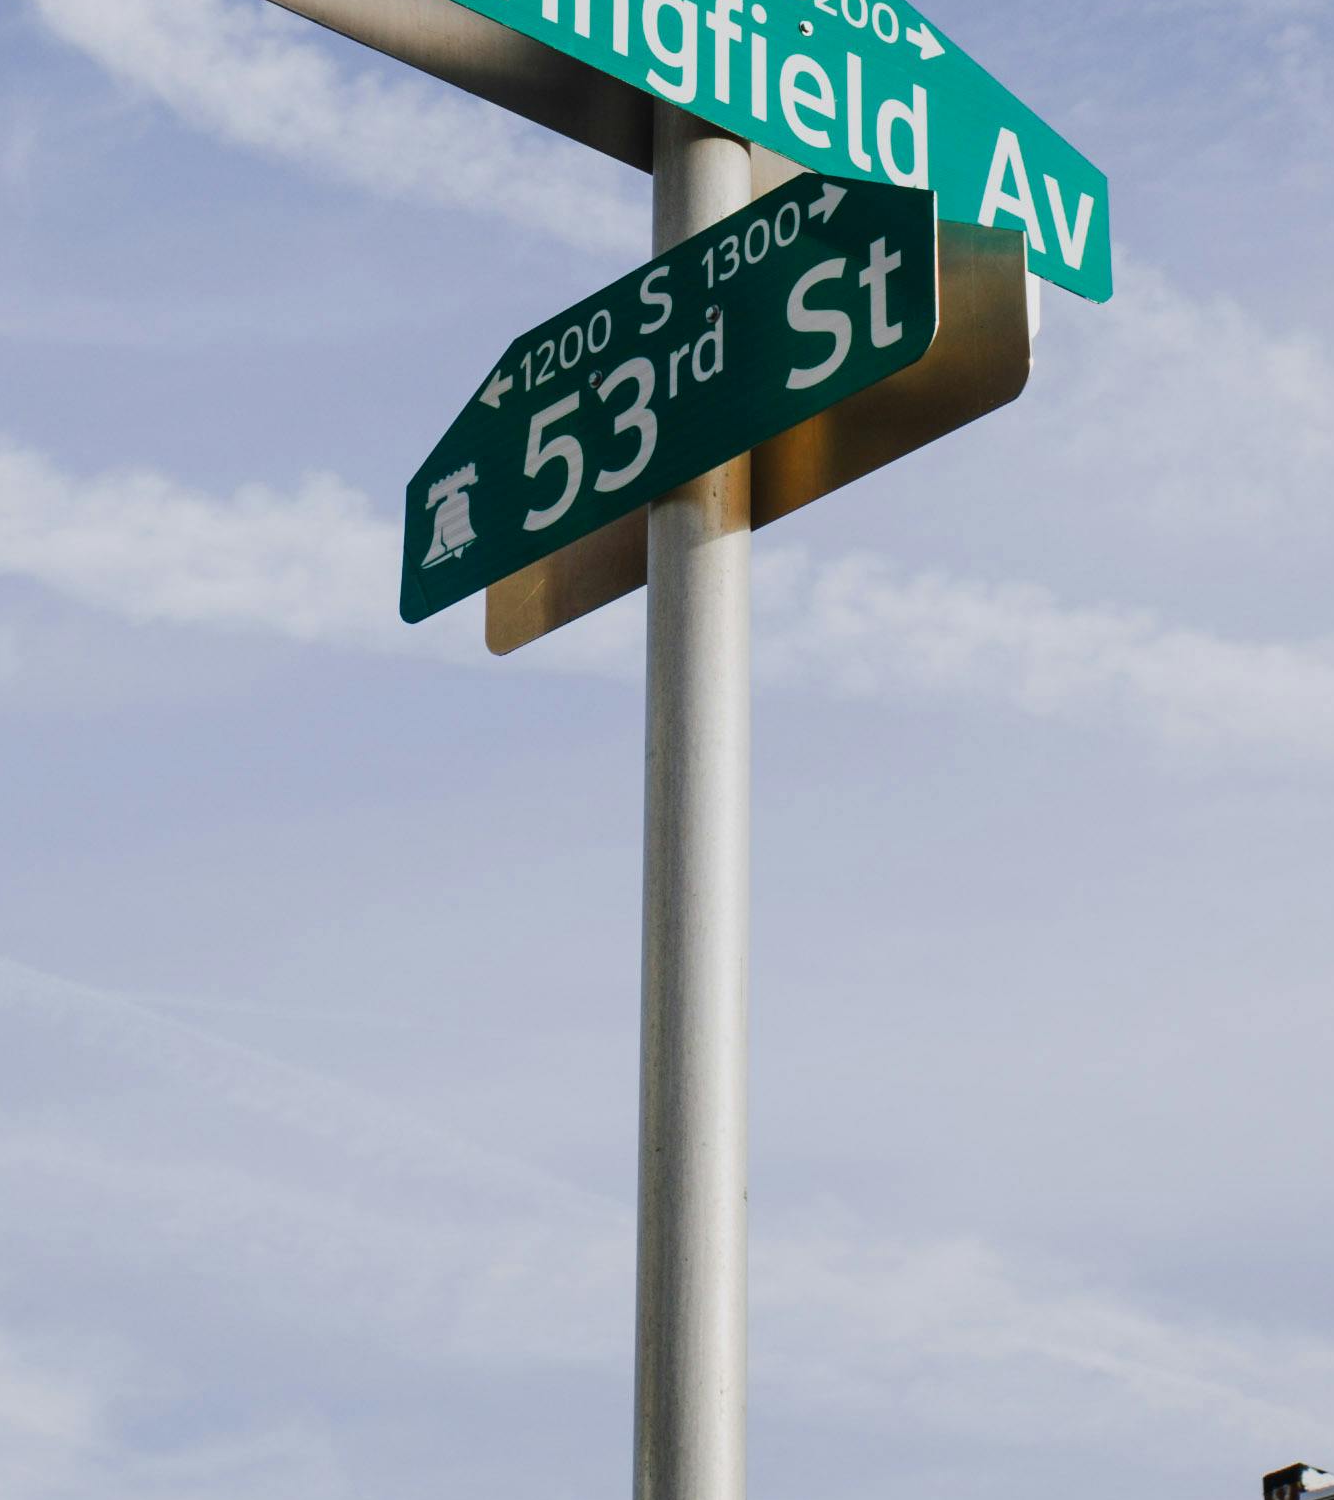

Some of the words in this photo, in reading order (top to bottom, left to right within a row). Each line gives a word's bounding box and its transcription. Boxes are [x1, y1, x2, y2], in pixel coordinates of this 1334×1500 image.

[977, 126, 1094, 270] Av
[520, 309, 612, 392] 1200
[639, 266, 673, 335] S
[701, 201, 801, 289] 1300
[523, 310, 724, 532] 53rd
[785, 236, 903, 390] St
